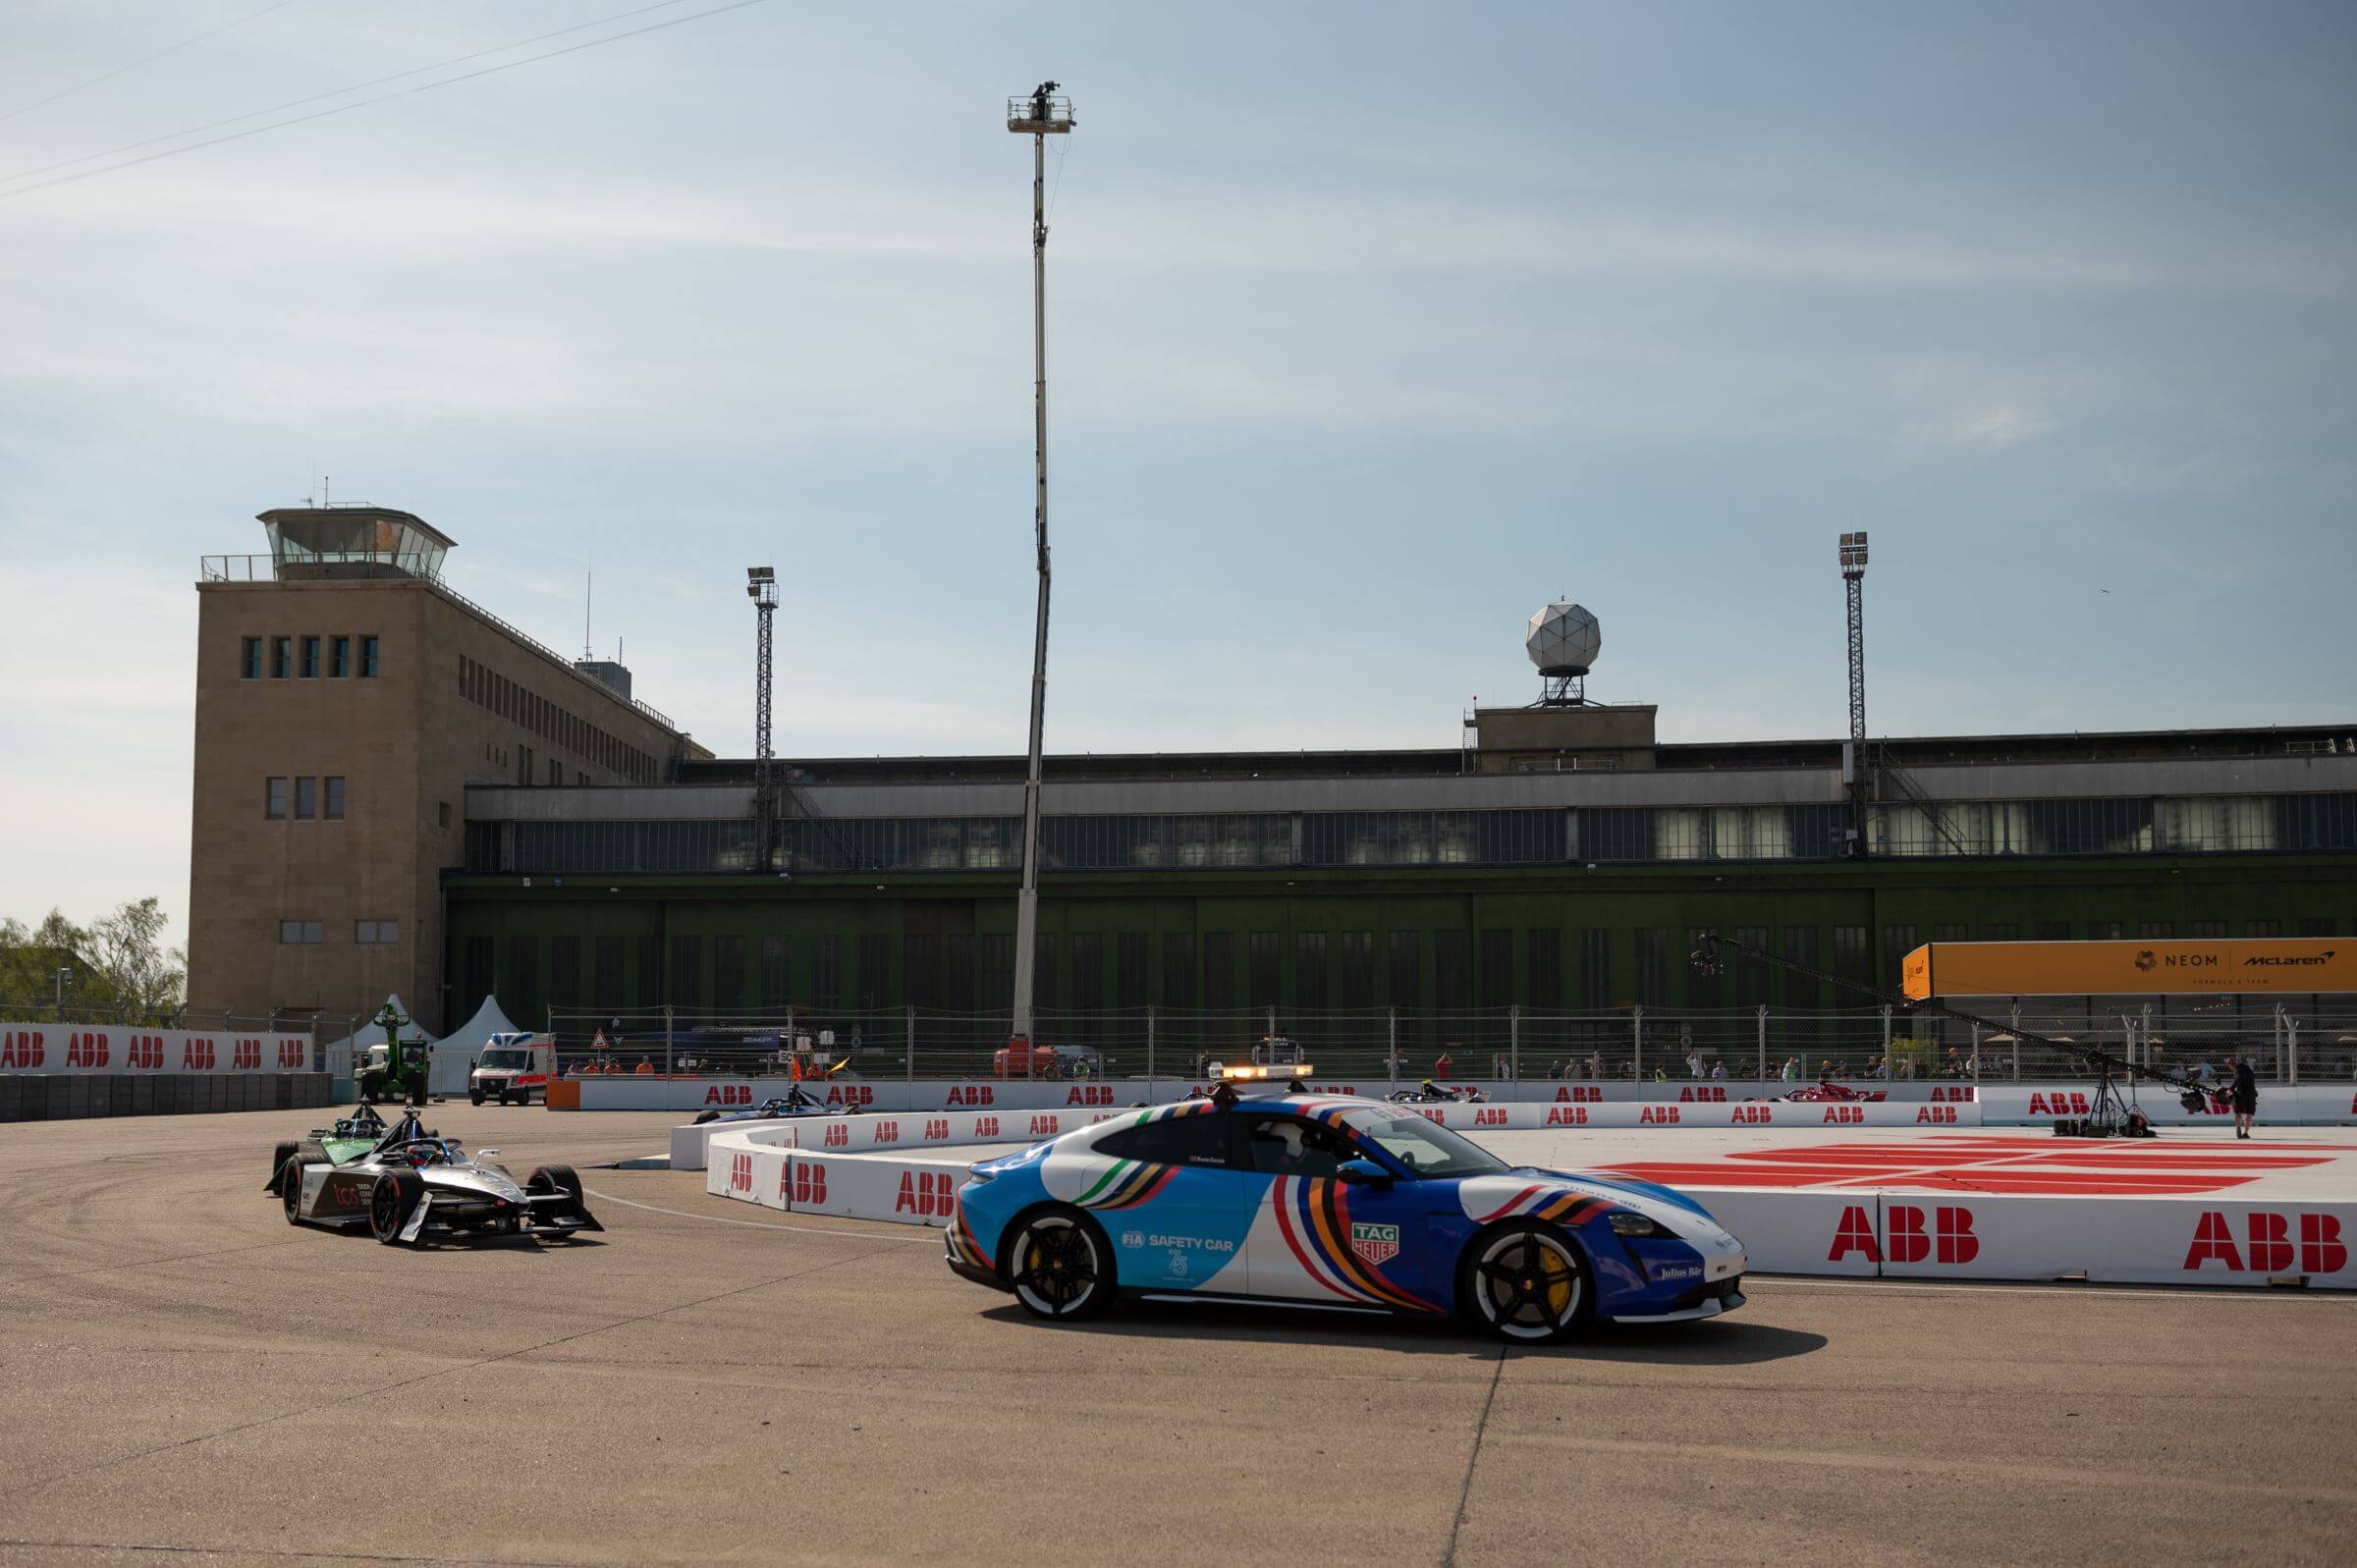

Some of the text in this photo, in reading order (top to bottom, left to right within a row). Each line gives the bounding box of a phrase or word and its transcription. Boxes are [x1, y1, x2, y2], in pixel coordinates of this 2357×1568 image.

[2165, 954, 2219, 967] NEOM
[2243, 952, 2331, 966] McLaren
[0, 1031, 45, 1069] ABB
[66, 1033, 110, 1068] ABB
[127, 1035, 165, 1070] ABB
[183, 1038, 216, 1070] ABB
[232, 1039, 261, 1069] ABB
[277, 1039, 304, 1068] ABB
[781, 1052, 793, 1062] SC
[704, 1086, 753, 1105] ABB
[826, 1086, 874, 1105] ABB
[947, 1086, 994, 1106] ABB
[1067, 1086, 1114, 1106] ABB
[1555, 1087, 1604, 1103] ABB
[1679, 1087, 1727, 1103] ABB
[2028, 1092, 2091, 1115] ABB
[1474, 1108, 1508, 1125] ABB
[1547, 1107, 1588, 1124] ABB
[1639, 1106, 1680, 1124] ABB
[1730, 1106, 1772, 1123] ABB
[1823, 1106, 1864, 1123] ABB
[1916, 1106, 1957, 1123] ABB
[874, 1121, 899, 1143] ABB
[924, 1119, 950, 1140] ABB
[974, 1117, 1000, 1137] ABB
[1029, 1115, 1059, 1135] ABB
[824, 1124, 849, 1147] ABB
[731, 1153, 752, 1193] ABB
[779, 1161, 828, 1206] ABB
[895, 1169, 955, 1217] ABB
[1123, 1232, 1233, 1252] FIA SAFETY CAR
[1355, 1225, 1395, 1240] TAG
[1828, 1206, 1980, 1264] ABB
[2183, 1212, 2347, 1273] ABB
[1354, 1240, 1398, 1262] HEUER
[1661, 1268, 1687, 1280] Julius
